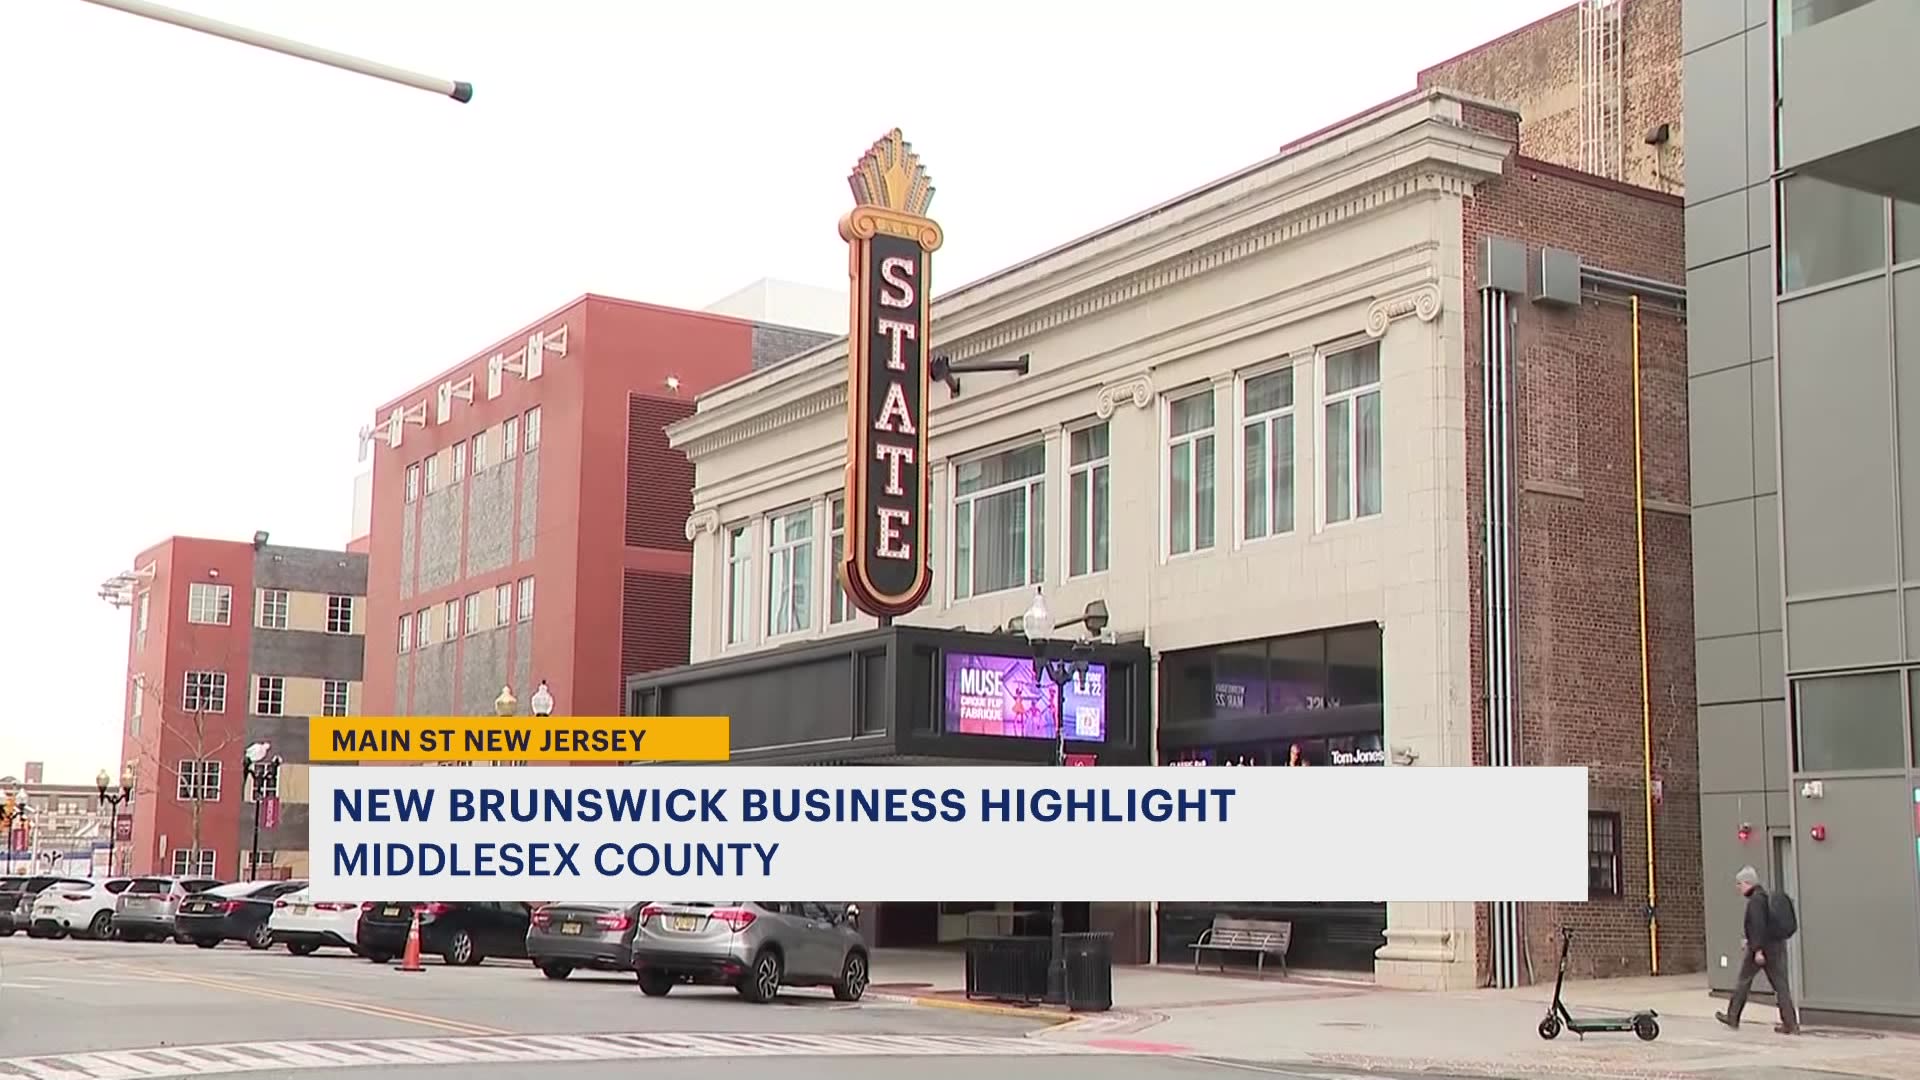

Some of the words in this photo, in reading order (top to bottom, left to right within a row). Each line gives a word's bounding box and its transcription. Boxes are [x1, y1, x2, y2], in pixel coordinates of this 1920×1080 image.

[875, 256, 916, 561] STATE
[961, 667, 1004, 696] MUSE
[1092, 682, 1101, 697] 22
[961, 706, 1004, 721] FABRIQUE
[1331, 750, 1352, 765] Tom
[1353, 748, 1384, 763] Jones
